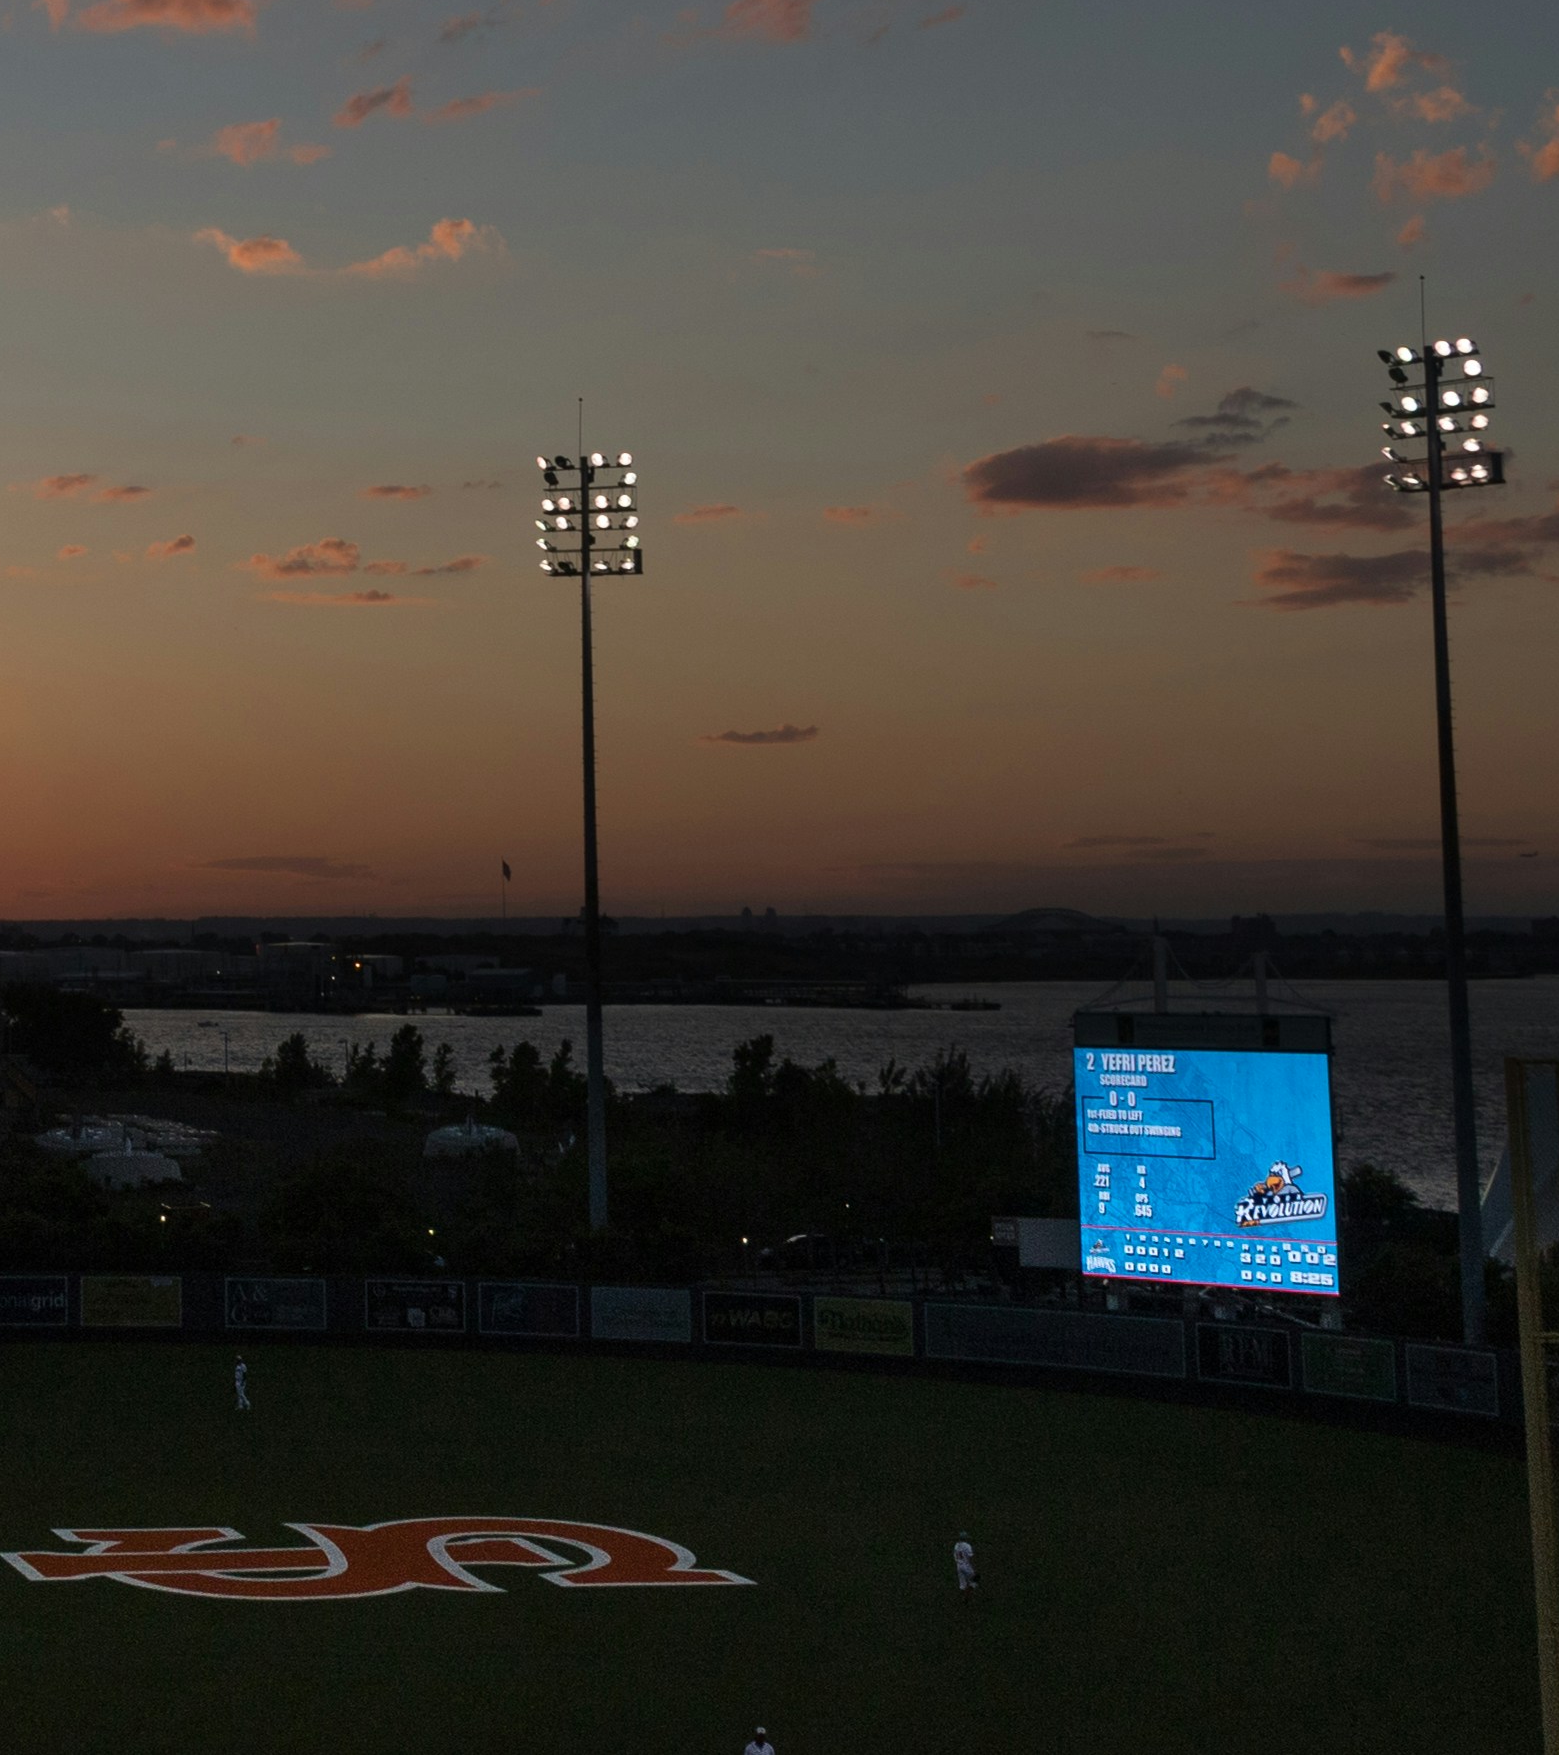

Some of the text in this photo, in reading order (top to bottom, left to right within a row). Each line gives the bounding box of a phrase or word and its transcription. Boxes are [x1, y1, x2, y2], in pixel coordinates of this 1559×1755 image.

[1086, 1052, 1176, 1074] 2 YEFRI PEREZ
[1099, 1074, 1148, 1087] SCORECARD
[1109, 1090, 1118, 1107] 0
[1127, 1091, 1136, 1107] 0
[1128, 1110, 1144, 1121] LEFT
[1234, 1197, 1323, 1223] REVOLUTION
[1086, 1255, 1116, 1274] HAWKS
[1290, 1271, 1334, 1286] 8:25
